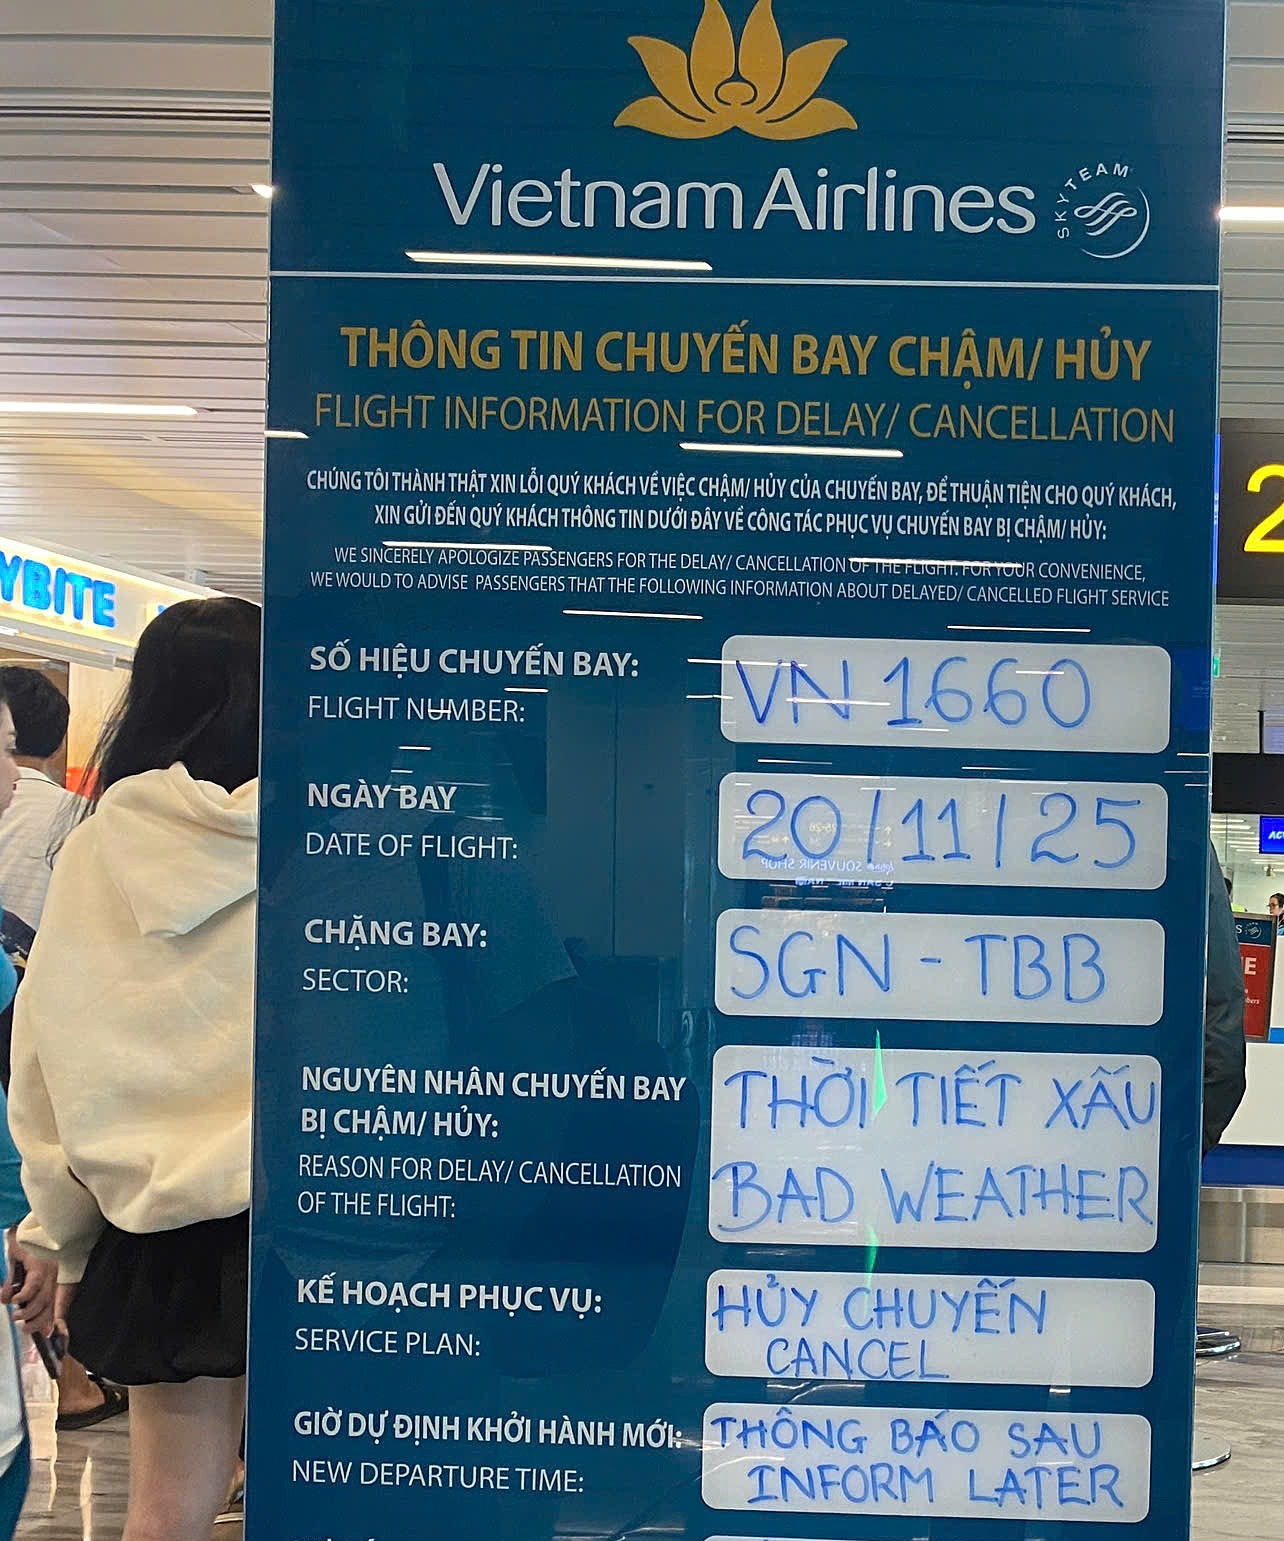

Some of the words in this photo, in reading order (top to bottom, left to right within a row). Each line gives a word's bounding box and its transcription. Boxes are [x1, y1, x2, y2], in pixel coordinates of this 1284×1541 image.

[433, 163, 743, 229] Vietnam
[753, 167, 1035, 233] Airlines
[1055, 162, 1130, 240] SKYTEAM
[341, 320, 499, 369] THÔNG
[512, 330, 582, 370] TIN
[596, 321, 778, 374] CHUYẾN
[793, 335, 876, 375] BAY
[890, 329, 1042, 388] CHẬM/
[1056, 326, 1150, 380] HỦY
[317, 394, 434, 427] FLIGHT
[447, 397, 684, 432] INFORMATION
[699, 400, 766, 434] FOR
[778, 401, 898, 435] DELAY/
[910, 404, 1173, 441] CANCELLATION
[307, 467, 361, 490] CHÚNG
[364, 468, 388, 490] TÔI
[392, 468, 445, 492] THÀNH
[448, 469, 487, 498] THẬT
[490, 474, 515, 493] XIN
[520, 467, 543, 493] LỖI
[547, 471, 580, 496] QUÝ
[584, 472, 636, 495] KHÁCH
[639, 470, 658, 495] VỀ
[661, 473, 695, 502] VIỆC
[699, 473, 750, 502] CHẬM/
[754, 472, 787, 498] HỦY
[790, 473, 821, 499] CỦA
[825, 475, 887, 500] CHUYẾN
[892, 481, 922, 504] BAY,
[926, 475, 948, 501] ĐỂ
[950, 480, 1003, 508] THUẬN
[1007, 480, 1041, 509] TIỆN
[1045, 485, 1078, 505] CHO
[1082, 482, 1115, 508] QUÝ
[1119, 483, 1176, 510] KHÁCH,
[375, 505, 400, 524] XIN
[404, 499, 431, 525] GỬI
[435, 500, 466, 525] ĐẾN
[470, 503, 502, 528] QUÝ
[507, 504, 558, 527] KHÁCH
[561, 505, 615, 528] THÔNG
[619, 509, 643, 528] TIN
[648, 506, 687, 529] DƯỚI
[691, 507, 722, 530] ĐÂY
[724, 505, 743, 530] VỀ
[747, 508, 791, 531] CÔNG
[794, 509, 822, 532] TÁC
[827, 514, 868, 539] PHỤC
[871, 515, 892, 540] VỤ
[897, 510, 959, 535] CHUYẾN
[964, 517, 992, 536] BAY
[997, 518, 1010, 543] BỊ
[1015, 513, 1066, 543] CHẬM/
[1071, 513, 1106, 540] HỦY:
[335, 547, 356, 562] WE
[361, 548, 434, 564] SINCERELY
[438, 549, 520, 566] APOLOGIZE
[523, 551, 613, 567] PASSENGERS
[418, 574, 468, 589] ADVISE
[476, 575, 565, 591] PASSENGERS
[568, 577, 605, 592] THAT
[608, 577, 635, 593] THE
[640, 578, 726, 594] FOLLOWING
[731, 581, 832, 598] INFORMATION
[837, 583, 888, 598] ABOUT
[892, 584, 963, 601] DELAYED/
[967, 586, 1052, 603] CANCELLED
[1057, 588, 1108, 605] FLIGHT
[1112, 590, 1169, 606] SERVICE
[311, 639, 350, 670] SỐ
[360, 643, 430, 679] HIỆU
[439, 643, 563, 675] CHUYẾN
[574, 652, 638, 677] BAY:
[309, 696, 400, 719] FLIGHT
[408, 698, 524, 722] NUMBER:
[736, 659, 852, 725] VN
[884, 657, 1093, 729] 1660
[308, 778, 391, 809] NGÀY
[400, 785, 458, 812] BAY
[307, 832, 370, 855] DATE
[379, 834, 413, 856] OF
[422, 835, 517, 859] FLIGHT:
[305, 915, 413, 951] CHẶNG
[423, 922, 486, 947] BAY:
[303, 968, 408, 993] SECTOR:
[729, 924, 891, 999] SGN
[964, 934, 1105, 1002] TBB
[303, 1064, 416, 1093] NGUYÊN
[425, 1066, 504, 1096] NHÂN
[512, 1067, 625, 1099] CHUYẾN
[634, 1076, 686, 1101] BAY
[723, 1056, 868, 1129] THỜI
[897, 1062, 1021, 1127] TIẾT
[1044, 1065, 1156, 1131] XẤU
[302, 1108, 325, 1139] BỊ
[334, 1105, 427, 1141] CHẬM/
[434, 1105, 498, 1138] HỦY:
[300, 1154, 383, 1178] REASON
[391, 1157, 432, 1180] FOR
[439, 1159, 514, 1183] DELAY/
[519, 1161, 680, 1187] CANCELLATION
[298, 1191, 326, 1213] OF
[331, 1192, 371, 1215] THE
[378, 1194, 455, 1218] FLIGHT:
[712, 1161, 855, 1232] BAD
[881, 1161, 1154, 1225] WEATHER
[298, 1272, 336, 1304] KẾ
[343, 1281, 450, 1313] HOẠCH
[460, 1284, 543, 1317] PHỤC
[550, 1287, 601, 1319] VỤ:
[711, 1273, 817, 1331] HỦY
[844, 1277, 1047, 1335] CHUYẾN
[295, 1328, 397, 1353] SERVICE
[407, 1332, 480, 1356] PLAN:
[766, 1337, 950, 1380] CANCEL
[294, 1407, 342, 1435] GIỜ
[349, 1410, 389, 1444] DỰ
[393, 1414, 459, 1446] ĐỊNH
[468, 1411, 531, 1443] KHỞI
[539, 1415, 614, 1446] HÀNH
[623, 1419, 686, 1448] MỚI:
[710, 1407, 867, 1454] THÔNG
[892, 1410, 979, 1457] BÁO
[1008, 1421, 1102, 1459] SAU
[293, 1460, 352, 1483] NEW
[361, 1463, 509, 1489] DEPARTURE
[515, 1468, 583, 1492] TIME:
[747, 1463, 934, 1505] INFORM
[968, 1464, 1125, 1508] LATER
